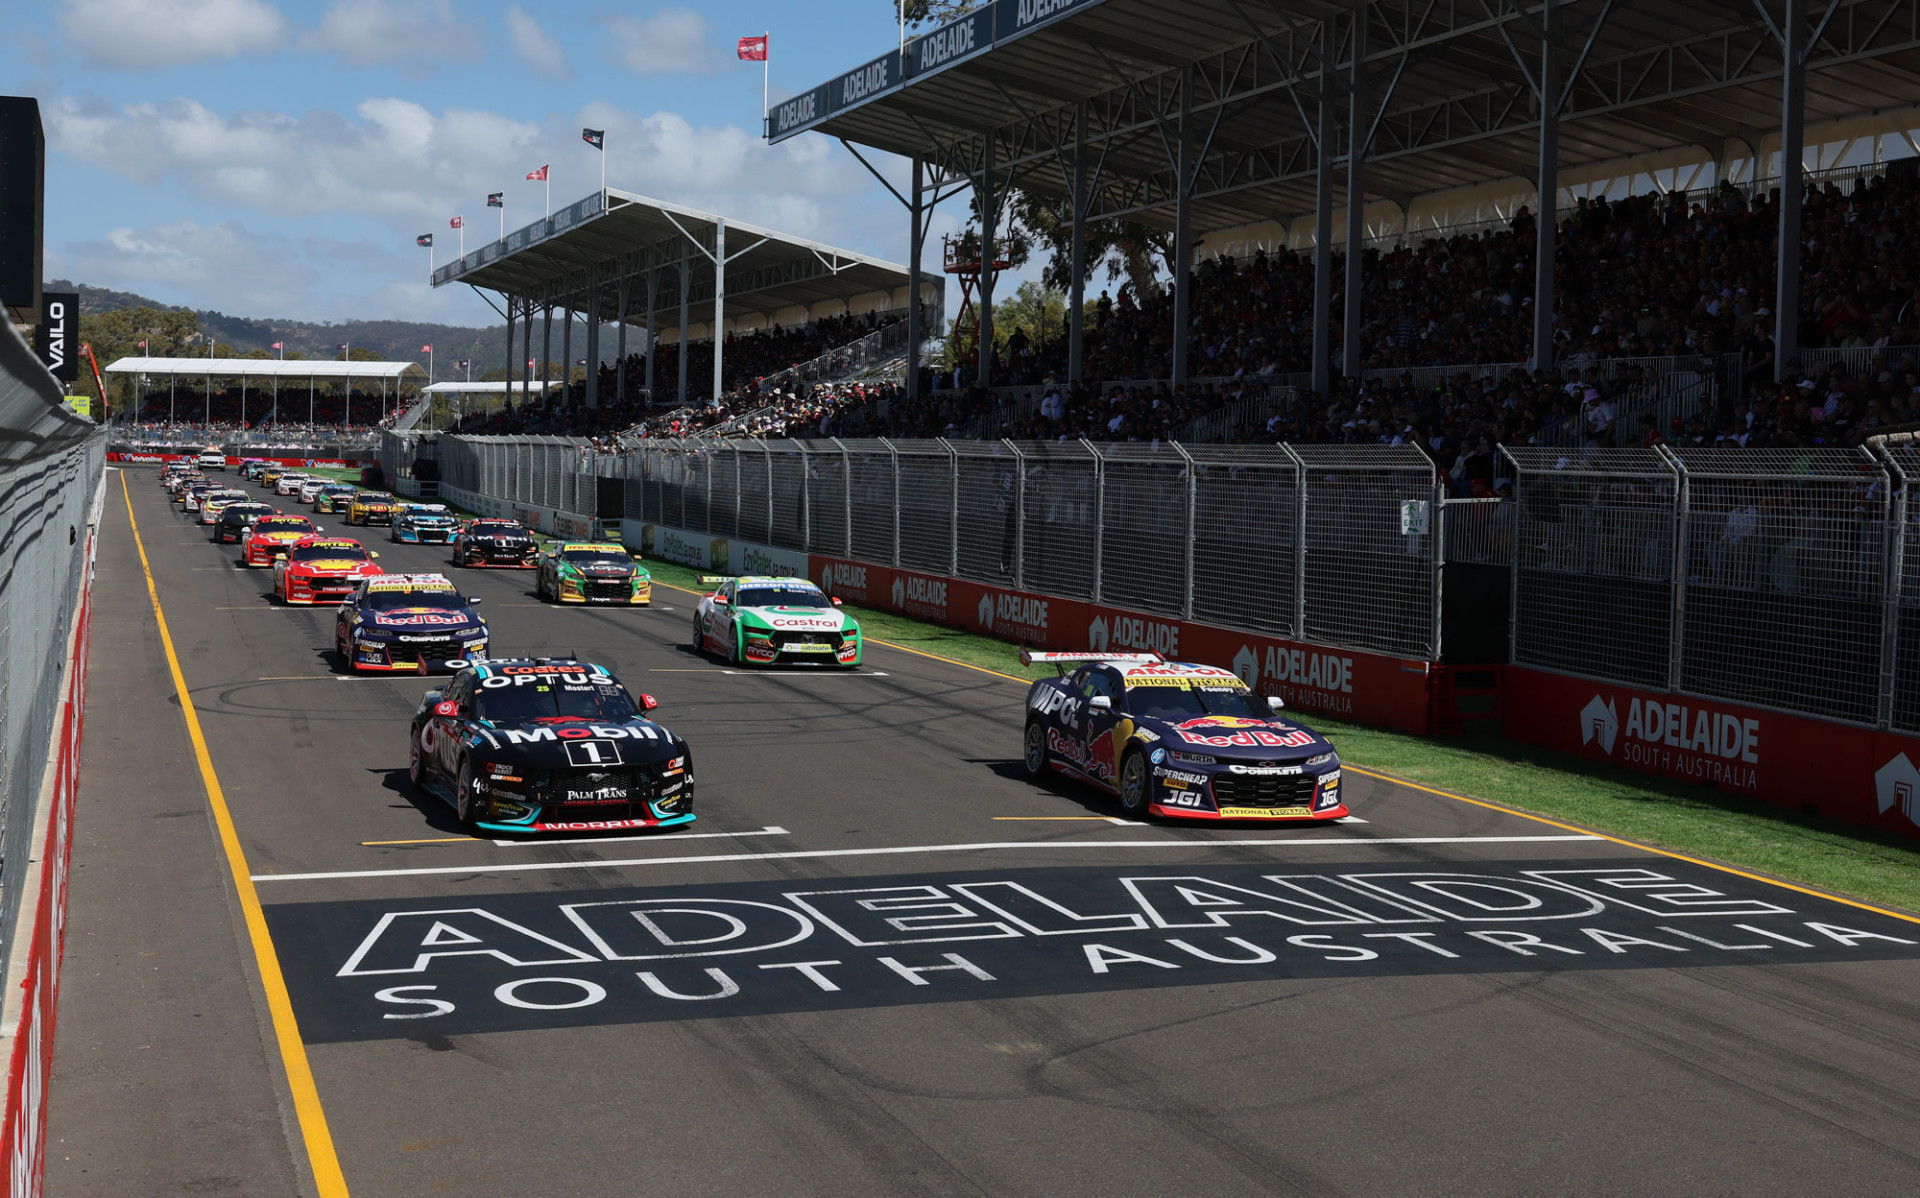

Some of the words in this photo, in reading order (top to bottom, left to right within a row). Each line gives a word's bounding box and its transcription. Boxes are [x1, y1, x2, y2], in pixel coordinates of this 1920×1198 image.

[920, 18, 974, 70] ADELAIDE
[843, 59, 887, 104] ADELAIDE
[779, 92, 815, 131] ADELAIDE
[49, 302, 65, 371] VAILO
[834, 563, 866, 589] ADELAIDE
[906, 577, 948, 606] ADELAIDE
[374, 614, 424, 625] Red
[424, 614, 468, 624] Bull
[773, 618, 838, 628] Castrol
[996, 593, 1048, 628] ADELAIDE
[1112, 616, 1179, 657] ADELAIDE
[748, 646, 774, 658] RYCO
[838, 648, 856, 660] RYCO
[482, 673, 614, 688] OPTUS
[502, 664, 586, 675] Coates
[1126, 678, 1187, 686] NATIONAL
[1190, 678, 1247, 686] STORAGE
[1264, 646, 1352, 693] ADELAIDE
[1031, 682, 1082, 729] AMPOL
[1263, 681, 1294, 703] SOUTH
[1298, 688, 1352, 714] AUSTRALIA
[504, 726, 658, 744] Mobil
[1176, 730, 1258, 747] Red
[1250, 730, 1316, 747] Bull
[1625, 697, 1760, 764] ADELAIDE
[580, 742, 602, 763] 1
[1047, 726, 1072, 758] Red
[1070, 736, 1087, 764] Bull
[1152, 766, 1208, 786] SUPERCHEAP
[1624, 742, 1671, 770] SOUTH
[1675, 753, 1758, 790] AUSTRALIA
[568, 790, 594, 800] PALM
[596, 790, 627, 800] TRANS
[1166, 780, 1186, 788] AUTO
[544, 820, 646, 830] MORRIS
[336, 868, 1797, 977] ADELAIDE
[374, 953, 998, 1019] SOUTH
[1083, 921, 1918, 974] AUSTRALIA
